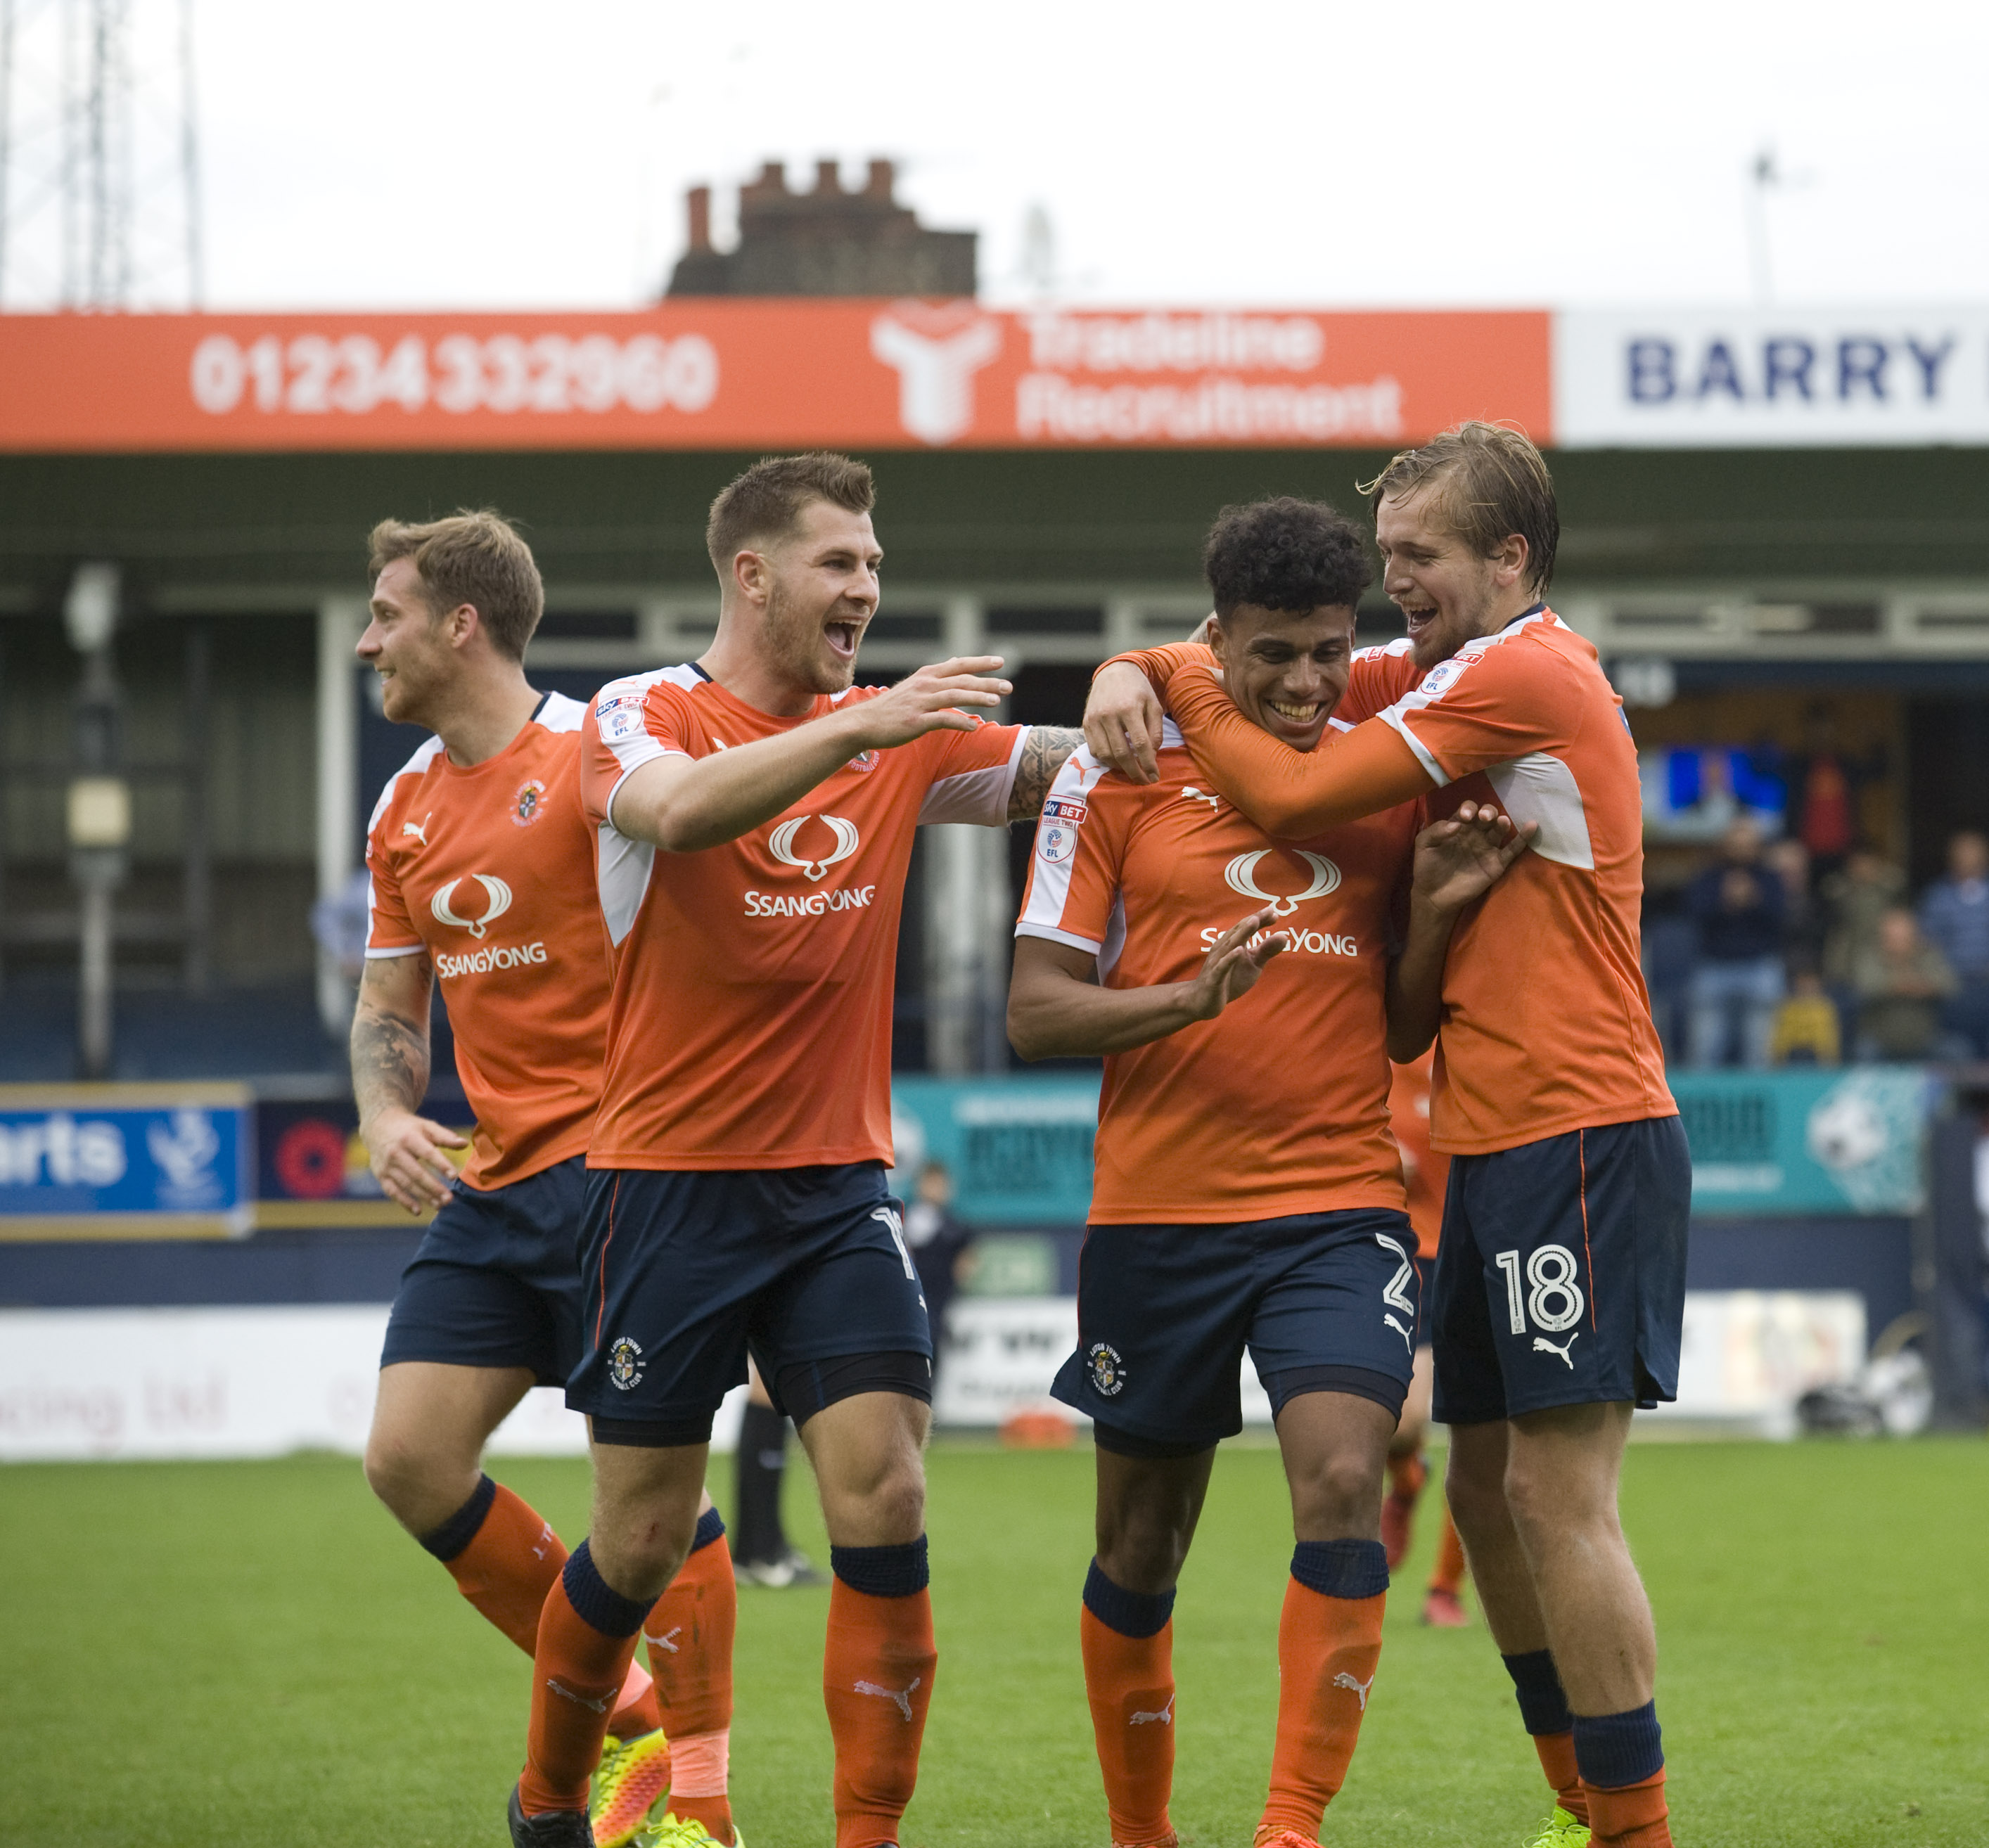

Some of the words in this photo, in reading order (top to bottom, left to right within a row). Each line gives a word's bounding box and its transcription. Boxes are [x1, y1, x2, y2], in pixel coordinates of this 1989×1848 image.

[1021, 313, 1325, 371] Tradeline
[1625, 335, 1955, 404] BARRY
[1017, 373, 1402, 440] Recruitment
[615, 726, 629, 736] EFL
[1044, 802, 1058, 816] sky
[1060, 805, 1083, 819] BET
[1044, 816, 1061, 825] LEAGUE
[1061, 819, 1073, 828] TWO
[1047, 849, 1058, 857] EFL
[1375, 1232, 1414, 1317] 2
[1496, 1244, 1584, 1335] 18
[626, 1337, 643, 1355] TOWN
[1089, 1343, 1104, 1357] LUTON
[1106, 1344, 1122, 1364] TOWN
